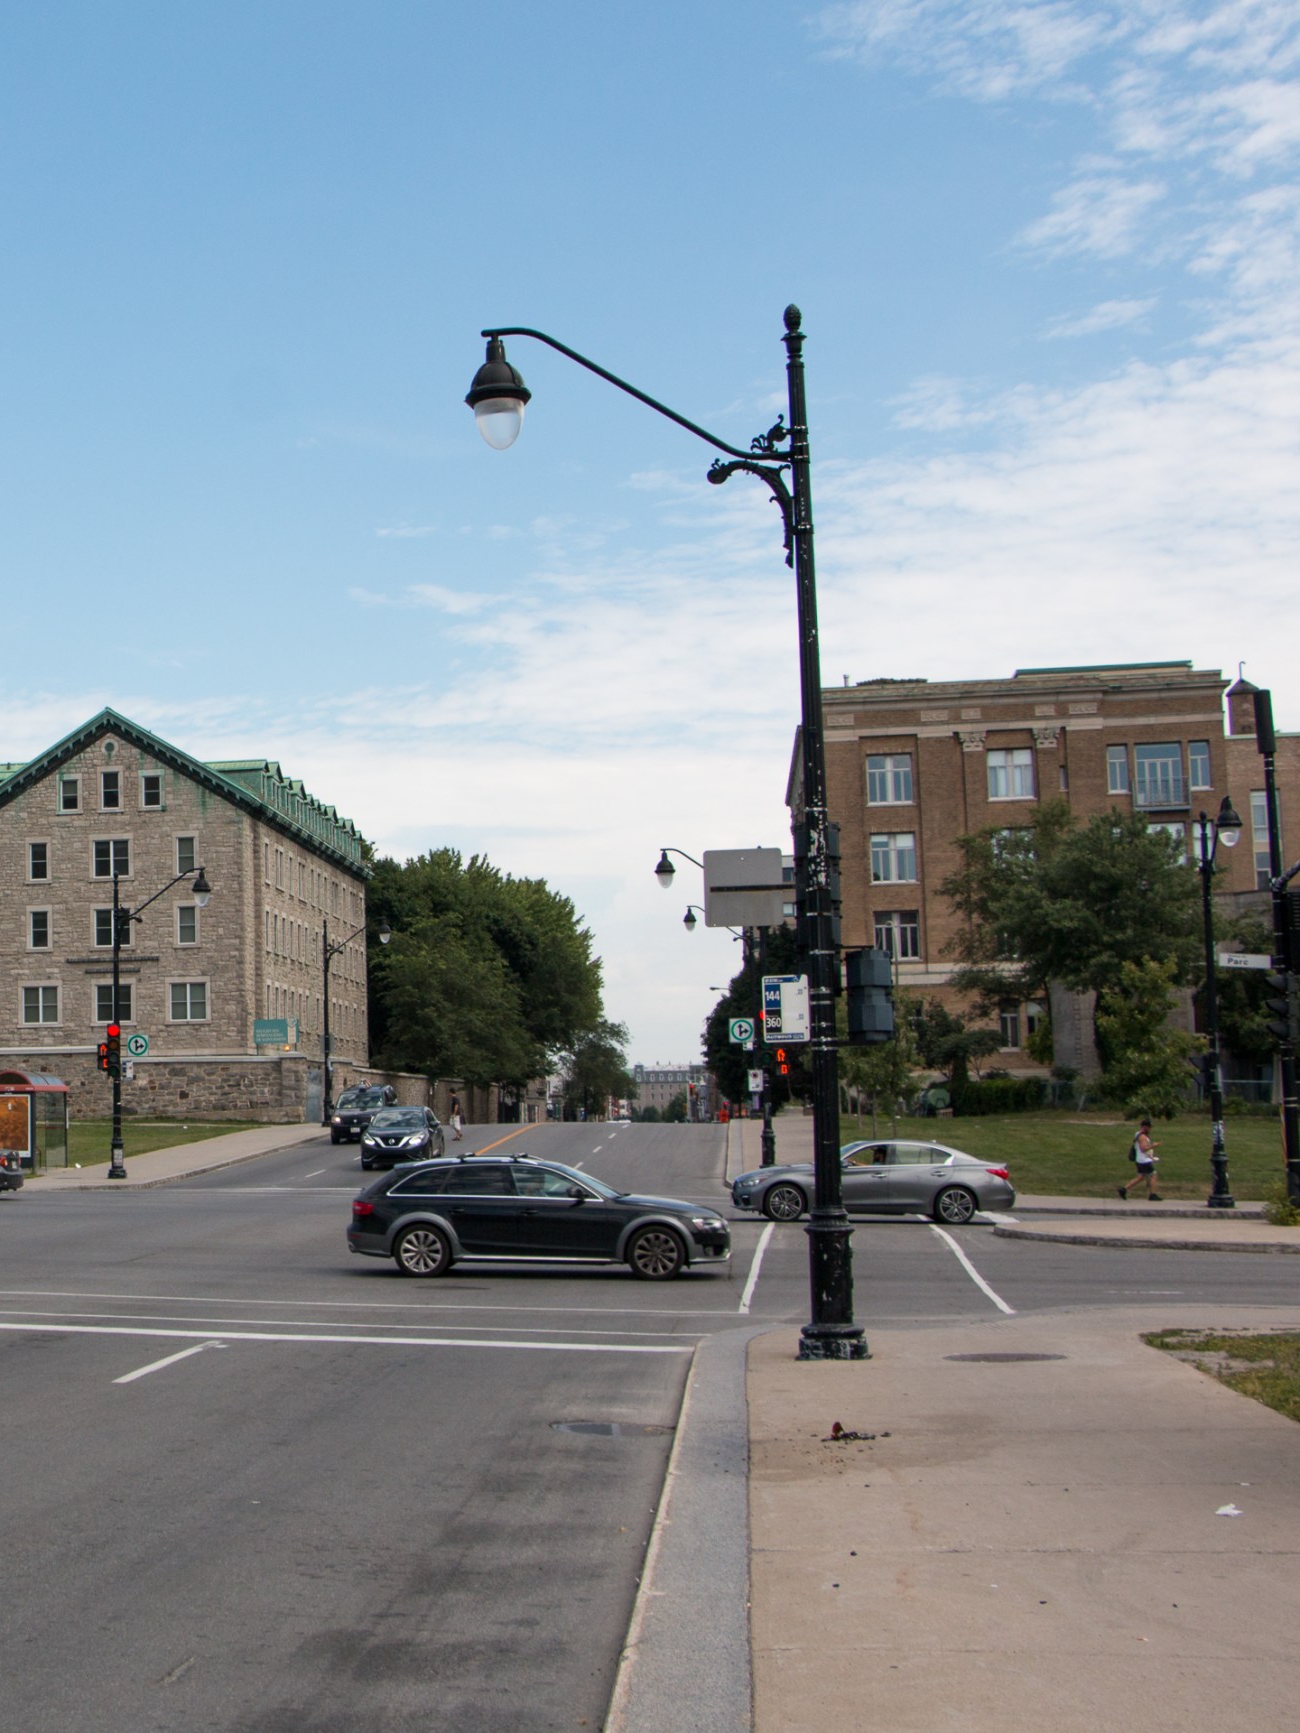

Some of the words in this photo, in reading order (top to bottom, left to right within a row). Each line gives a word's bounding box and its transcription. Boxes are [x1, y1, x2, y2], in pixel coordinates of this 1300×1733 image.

[1227, 957, 1249, 966] Parc
[765, 991, 780, 1001] 144
[766, 1017, 782, 1028] 360
